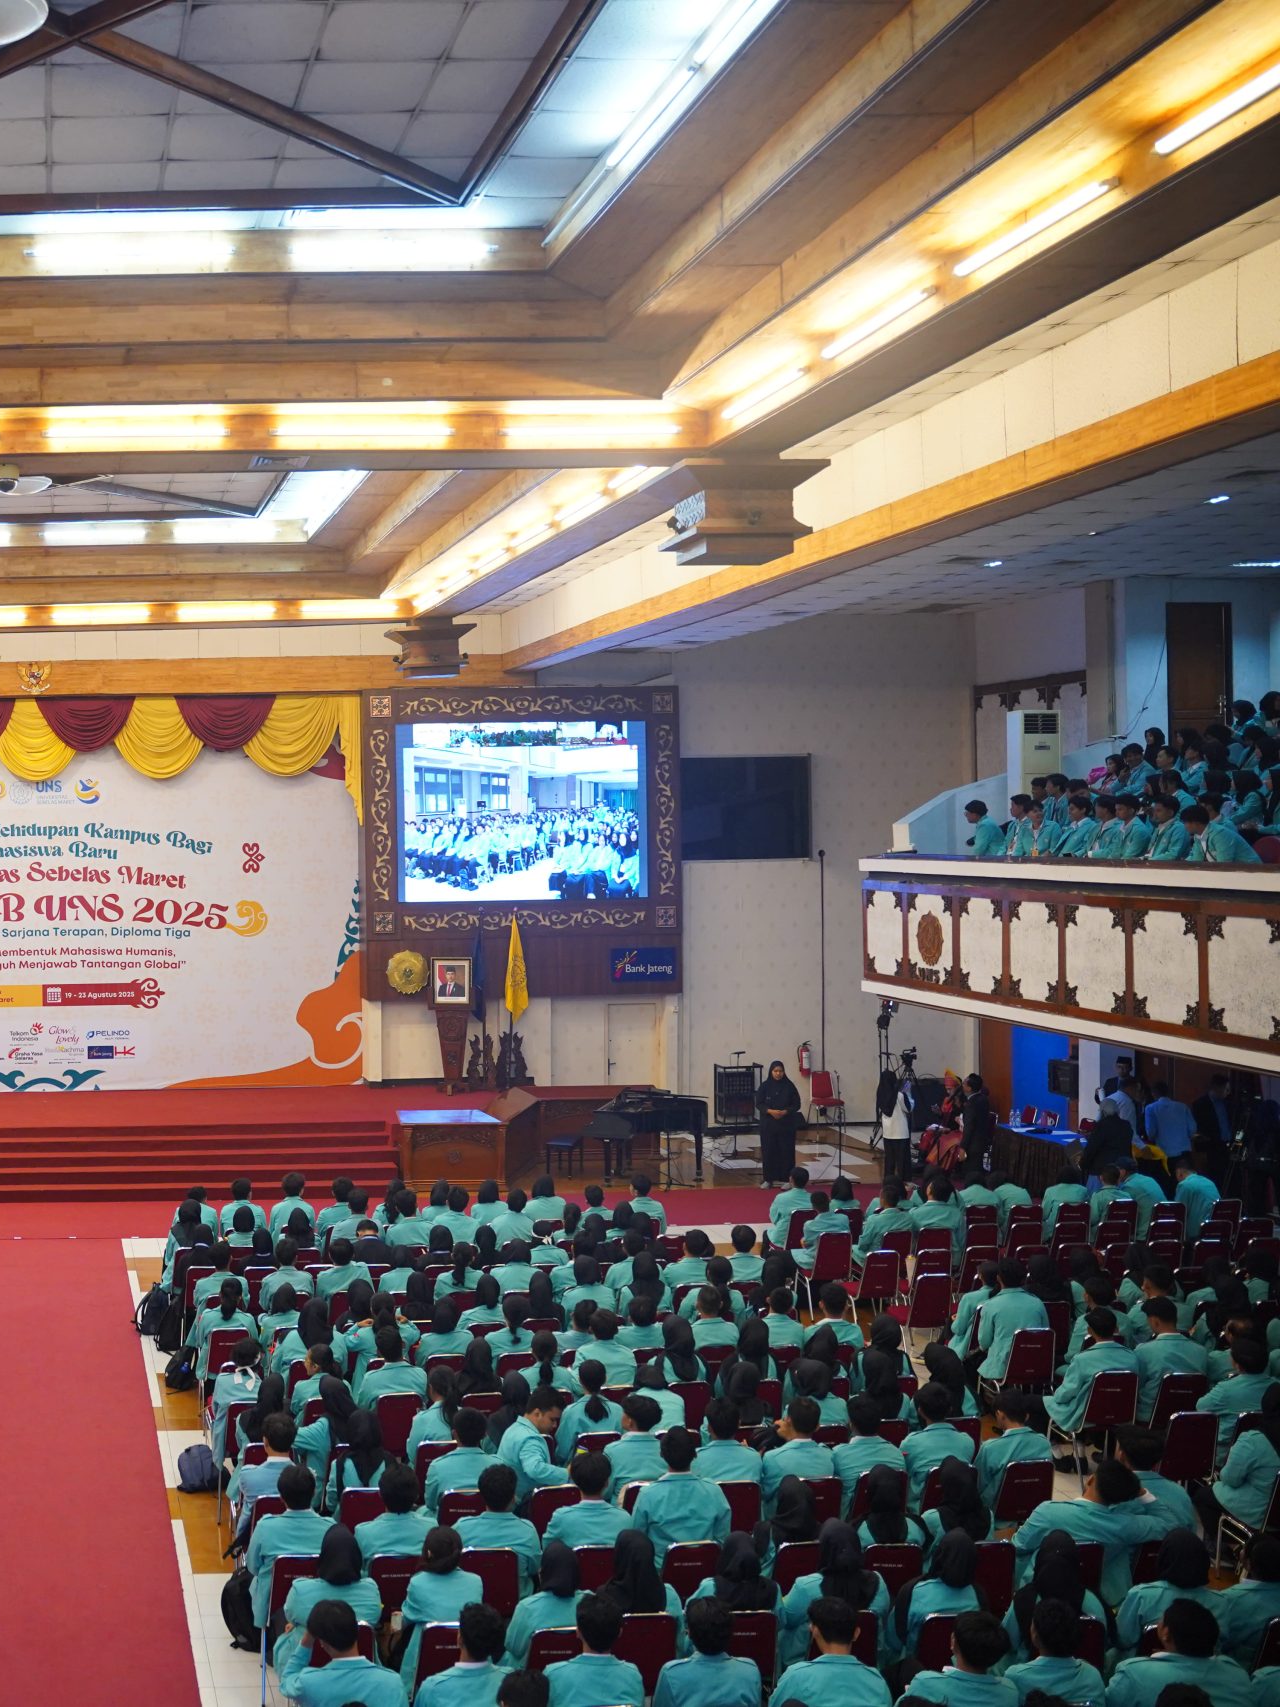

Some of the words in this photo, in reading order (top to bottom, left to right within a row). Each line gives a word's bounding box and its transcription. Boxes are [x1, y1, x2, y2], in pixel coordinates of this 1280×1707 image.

[36, 780, 62, 793] UNS
[84, 822, 161, 846] Kampus
[166, 830, 214, 855] Bagi
[68, 840, 118, 860] Baru
[26, 861, 111, 884] Sebelas
[117, 865, 187, 889] Maret
[33, 893, 125, 923] UNS
[131, 897, 229, 930] 2025
[1, 927, 50, 940] Sarjana
[52, 927, 108, 939] Terapan,
[111, 927, 162, 939] Diploma
[164, 927, 191, 940] Tiga
[59, 946, 123, 956] Mahasiswa
[125, 946, 176, 958] Humanis,
[19, 960, 78, 971] Menjawab
[80, 960, 142, 971] Tantangan
[625, 963, 646, 973] Bank
[646, 963, 673, 975] Jateng
[88, 991, 117, 999] Agustus
[49, 1025, 71, 1035] Glow
[95, 1029, 130, 1037] PELINDO
[56, 1034, 80, 1045] Lovely
